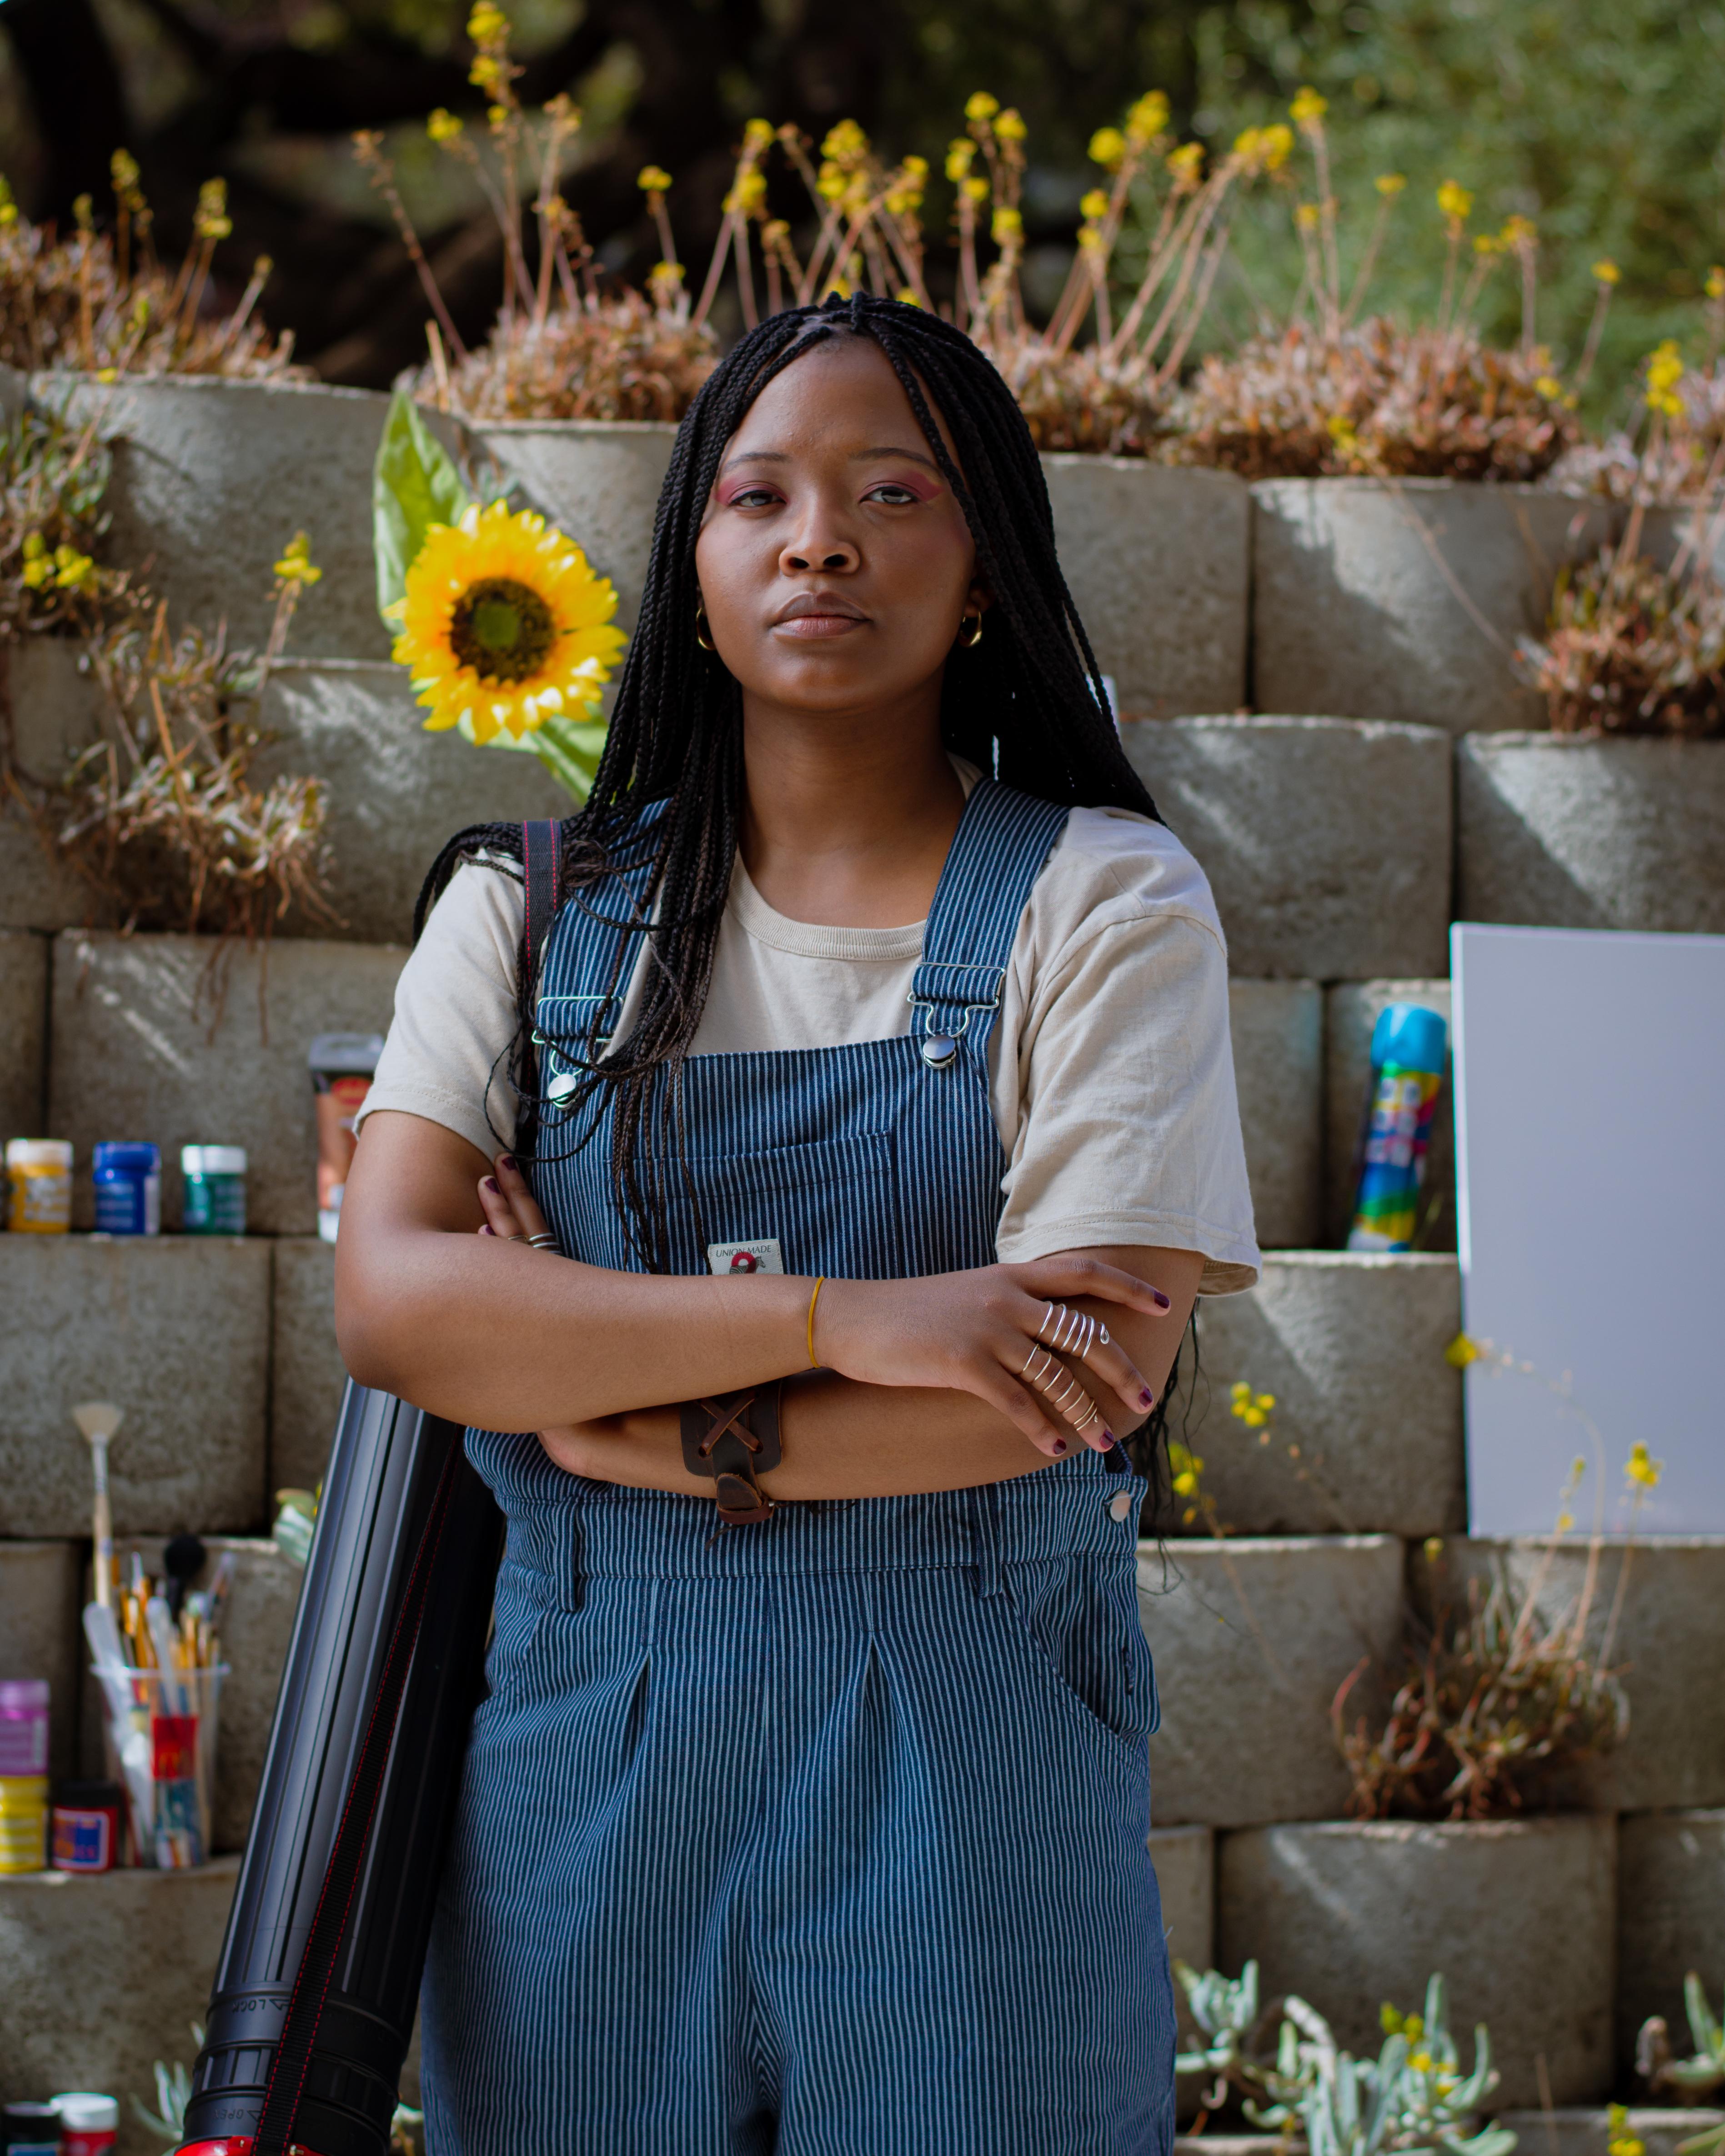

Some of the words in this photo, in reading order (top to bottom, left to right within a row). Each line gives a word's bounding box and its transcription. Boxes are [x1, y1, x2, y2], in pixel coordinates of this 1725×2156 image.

[716, 1247, 744, 1258] UNION
[747, 1245, 771, 1254] MADE
[232, 1999, 266, 2013] LOCK
